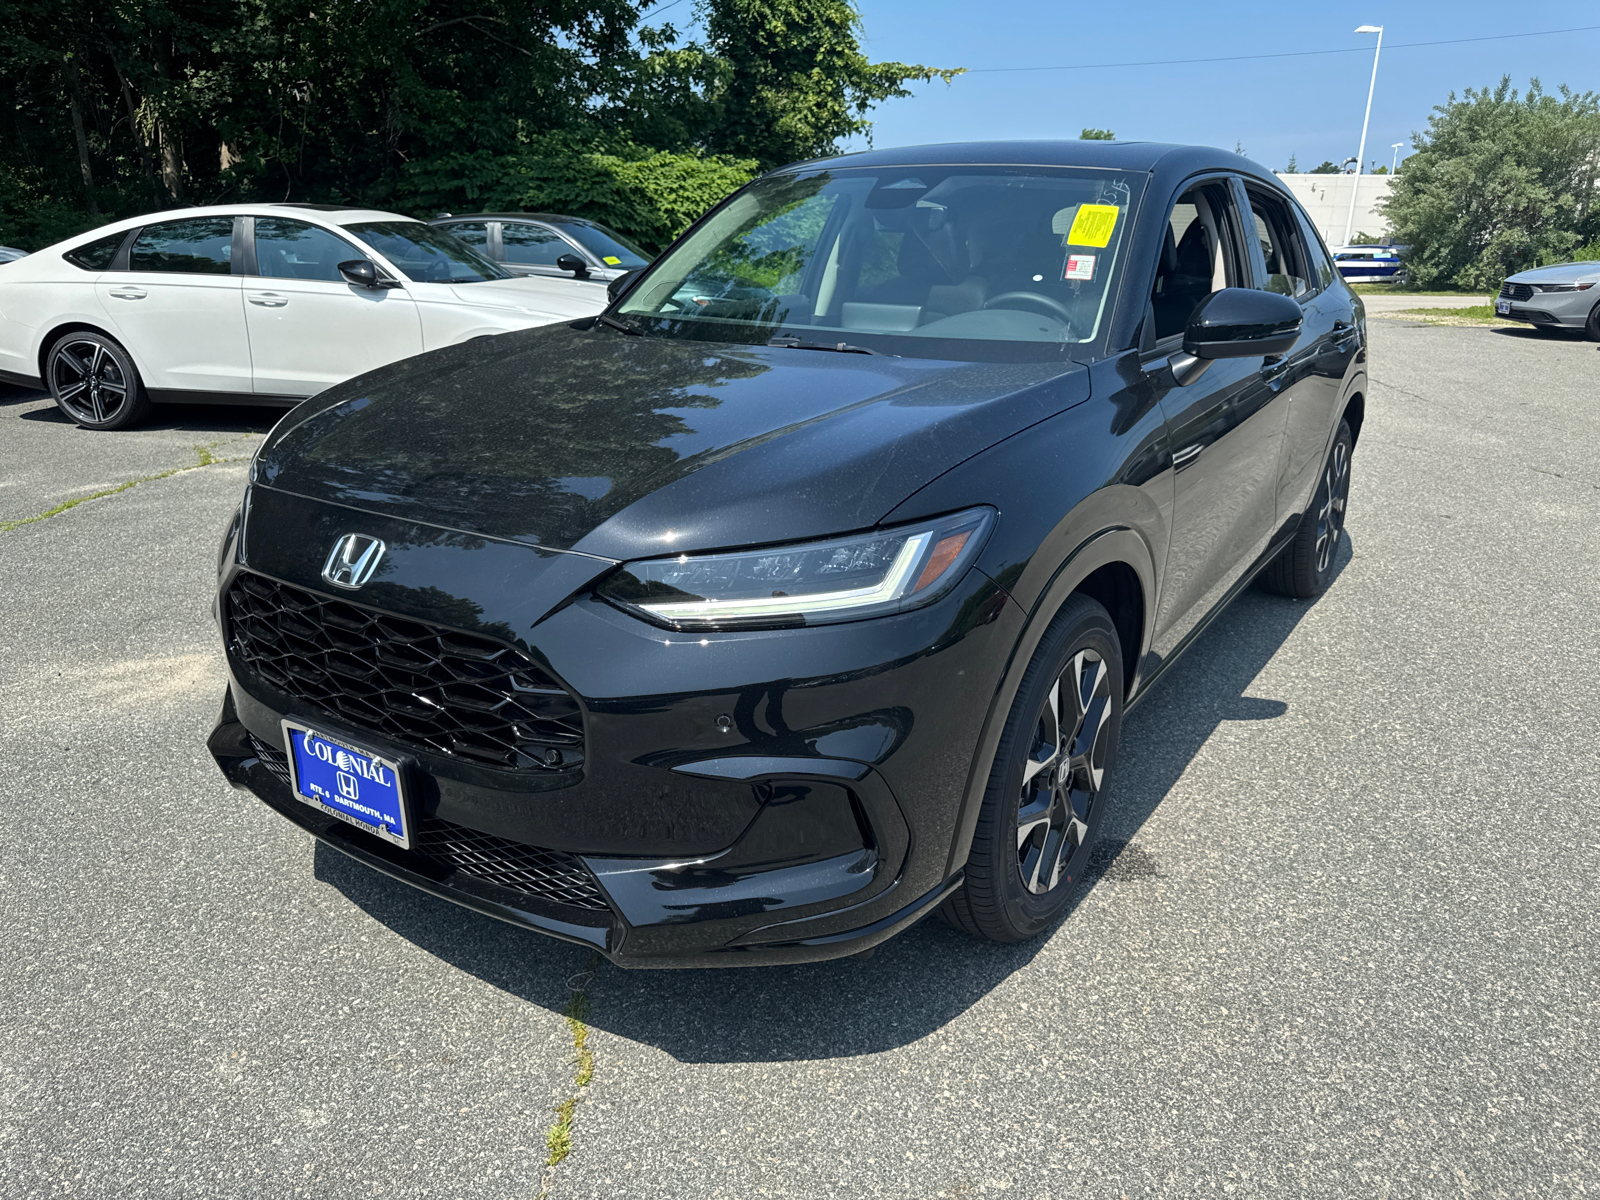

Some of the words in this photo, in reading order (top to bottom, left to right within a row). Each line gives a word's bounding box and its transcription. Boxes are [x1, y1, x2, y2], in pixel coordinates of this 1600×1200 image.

[303, 735, 391, 788] COLONIAL
[310, 782, 325, 796] RTE.
[325, 791, 330, 799] 6
[334, 795, 383, 821] DARTMOUTH,
[383, 813, 396, 825] MA
[320, 804, 355, 826] COLONIAL
[355, 818, 381, 836] HONDA
